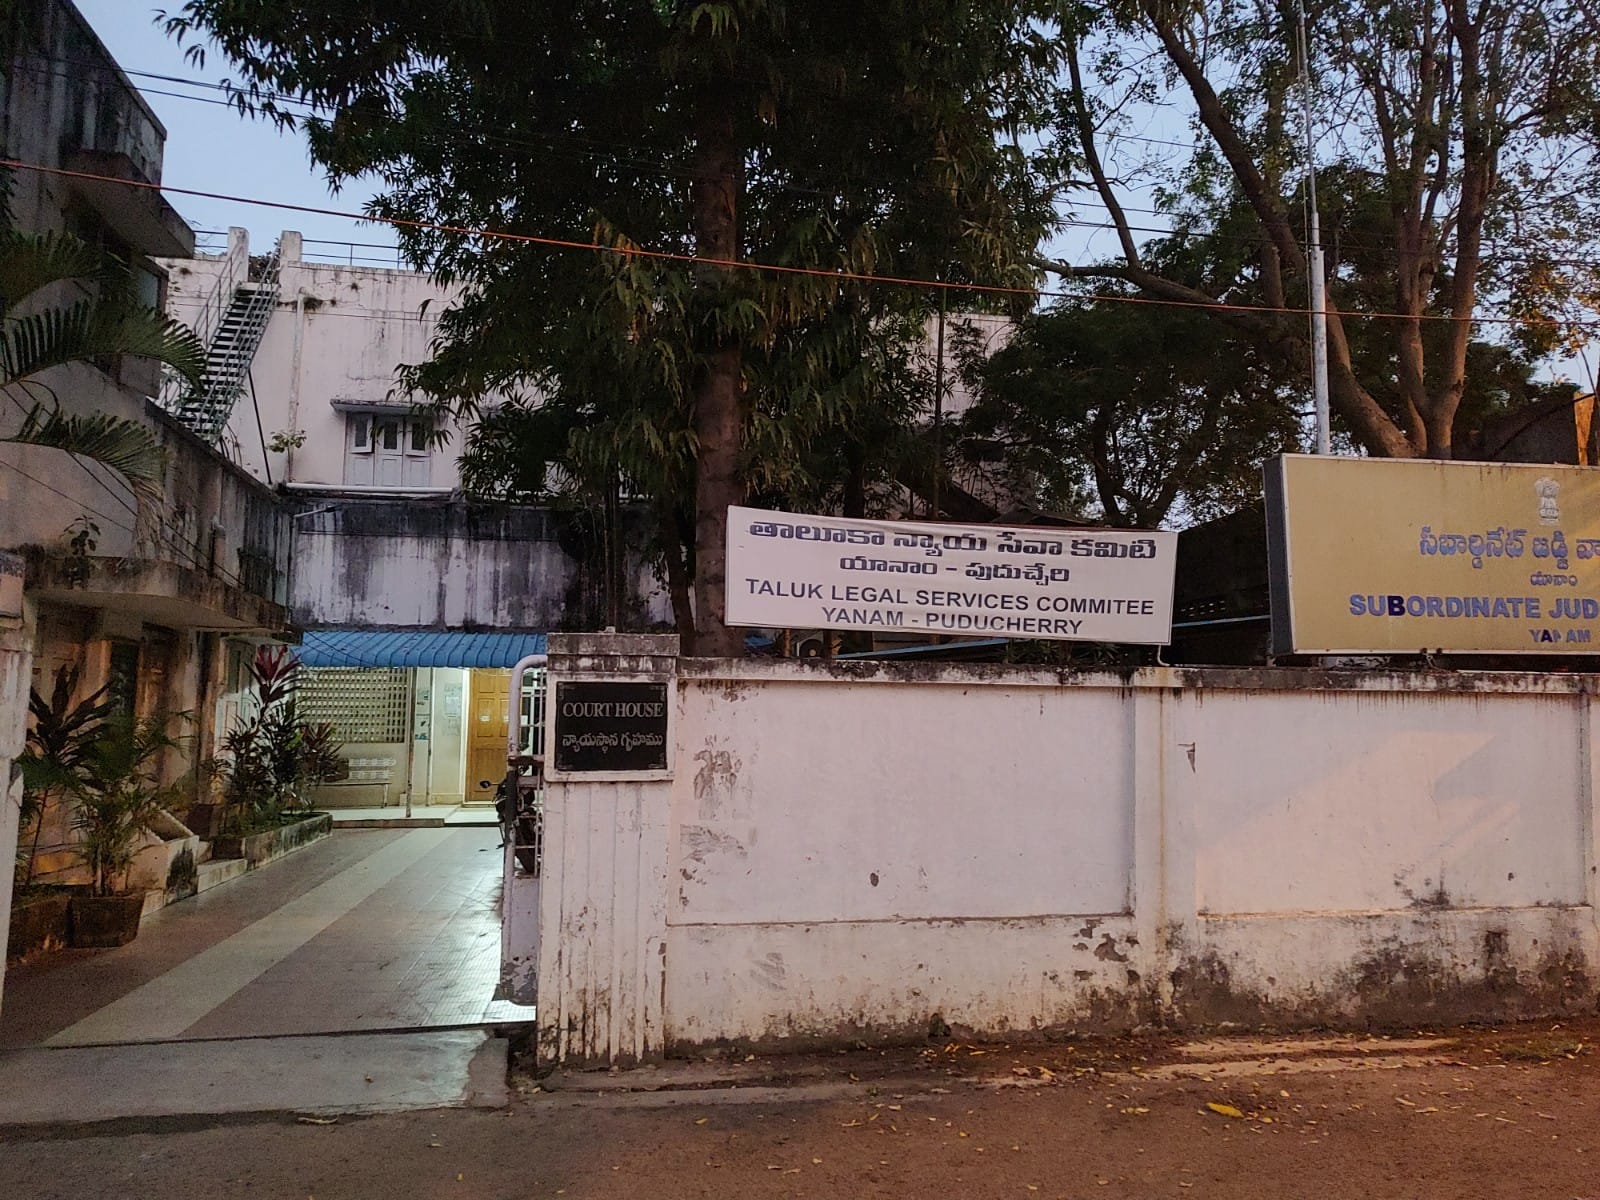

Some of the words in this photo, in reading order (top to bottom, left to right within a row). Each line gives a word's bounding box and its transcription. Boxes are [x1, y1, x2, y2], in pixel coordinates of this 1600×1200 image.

[750, 521, 885, 546] తాలూకా
[893, 531, 988, 557] న్యాయ
[997, 531, 1063, 556] సేవా
[840, 555, 938, 575] యానాం
[965, 562, 1070, 586] పుదుచ్చేరి
[745, 578, 823, 600] TALUK
[831, 584, 909, 605] LEGAL
[916, 589, 1029, 612] SERVICES
[1036, 596, 1155, 616] COMMITEE
[1350, 594, 1541, 620] SUBORDINATE
[1548, 597, 1599, 620] JUD
[822, 606, 904, 627] YANAM
[926, 611, 1083, 635] PUDUCHERRY
[562, 702, 613, 718] COURT
[615, 702, 664, 718] HOUSE
